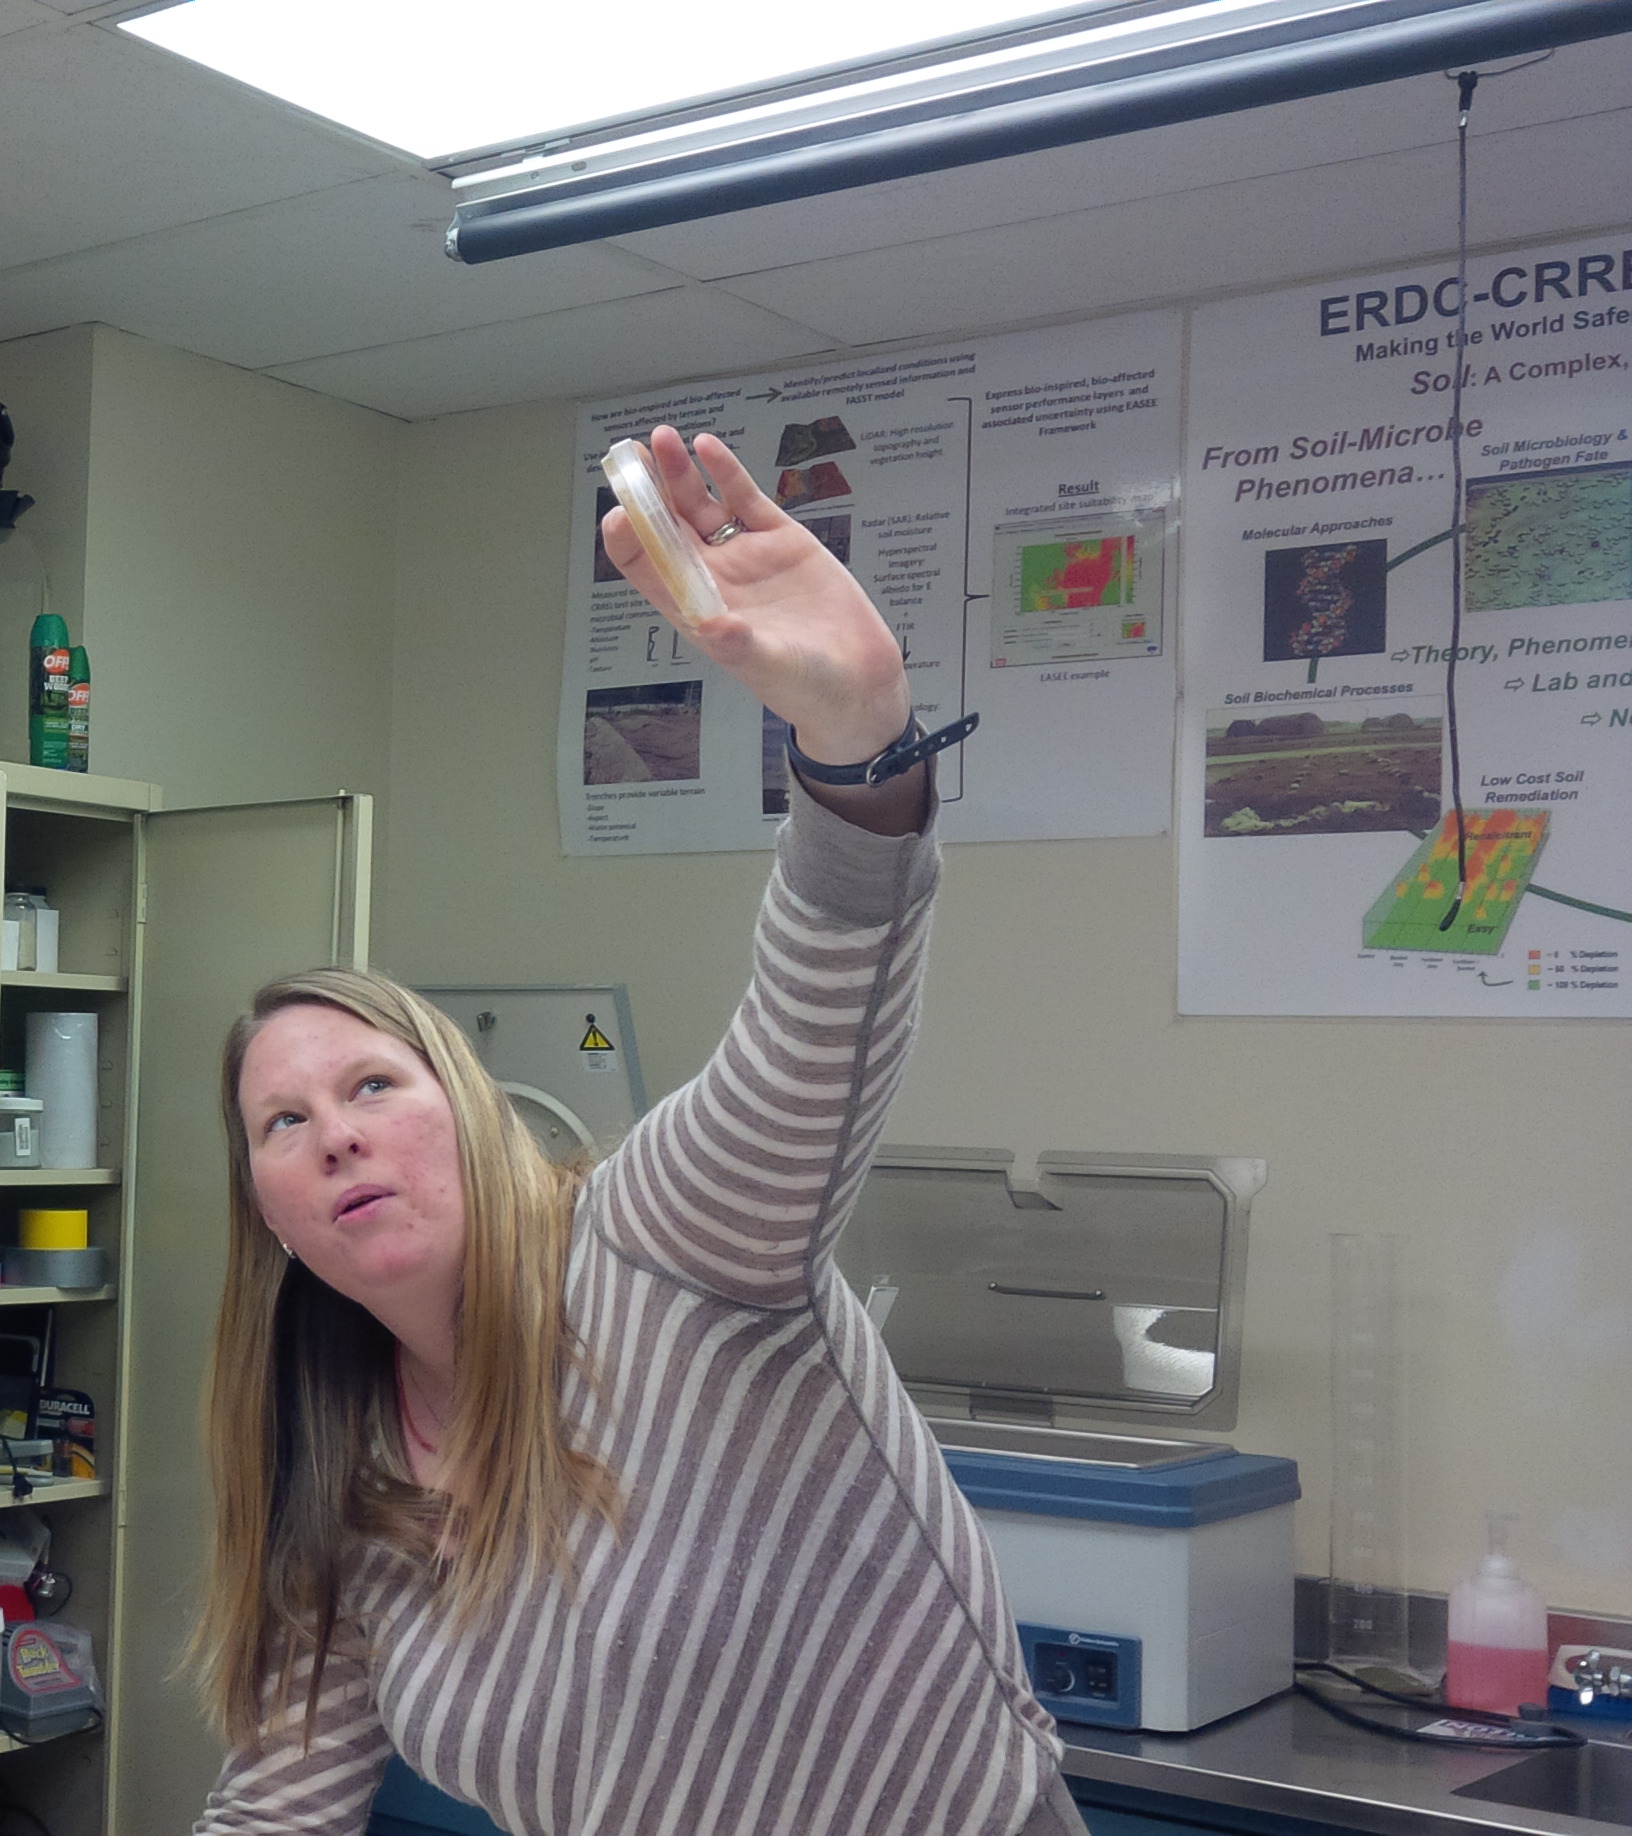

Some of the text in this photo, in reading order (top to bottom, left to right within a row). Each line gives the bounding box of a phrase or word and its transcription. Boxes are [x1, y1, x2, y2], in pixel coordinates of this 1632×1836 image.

[1355, 331, 1440, 363] Making
[1490, 313, 1565, 342] World
[1572, 306, 1631, 331] Safe
[985, 389, 1023, 402] Express
[1091, 369, 1155, 386] bio-affected
[1410, 352, 1630, 396] Sol: A Complex,
[990, 385, 1149, 415] sensor performance layers and
[982, 413, 1033, 430] associated
[1035, 406, 1095, 423] uncertainty
[1096, 402, 1125, 415] using
[1039, 420, 1097, 437] Framework
[1201, 416, 1485, 471] From Soil-Microbe
[1480, 427, 1630, 458] Soil Microbiology &
[1499, 448, 1609, 473] Pathogen Fate
[1058, 480, 1100, 495] Result
[1234, 460, 1446, 502] Phenomena...
[1242, 515, 1394, 541] Molecular Approaches
[1412, 634, 1632, 665] Theory, Phenome
[1224, 682, 1414, 706] Soil Biochemical Processes
[1531, 671, 1632, 693] Lab and
[1481, 770, 1585, 787] Low Cost Soil
[1485, 789, 1579, 804] Remediation
